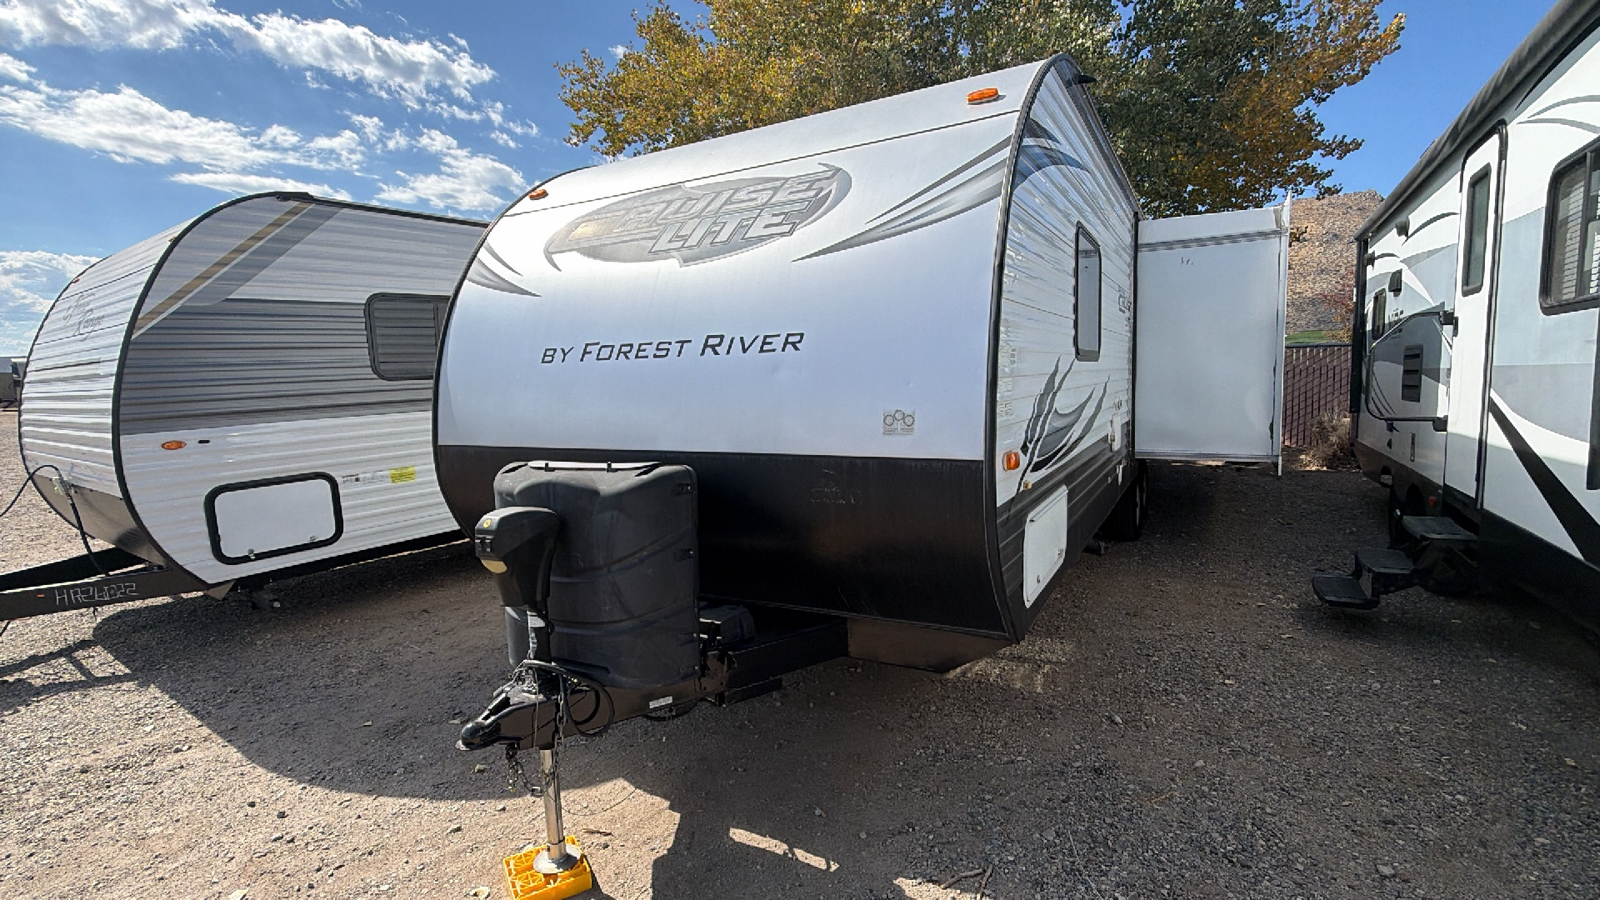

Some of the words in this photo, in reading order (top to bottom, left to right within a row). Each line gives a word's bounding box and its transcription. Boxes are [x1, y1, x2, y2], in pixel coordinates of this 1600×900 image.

[550, 169, 841, 252] CRUISE
[648, 199, 814, 255] LITE
[541, 346, 574, 365] BY
[580, 339, 692, 363] FOREST
[700, 332, 805, 357] RIVER
